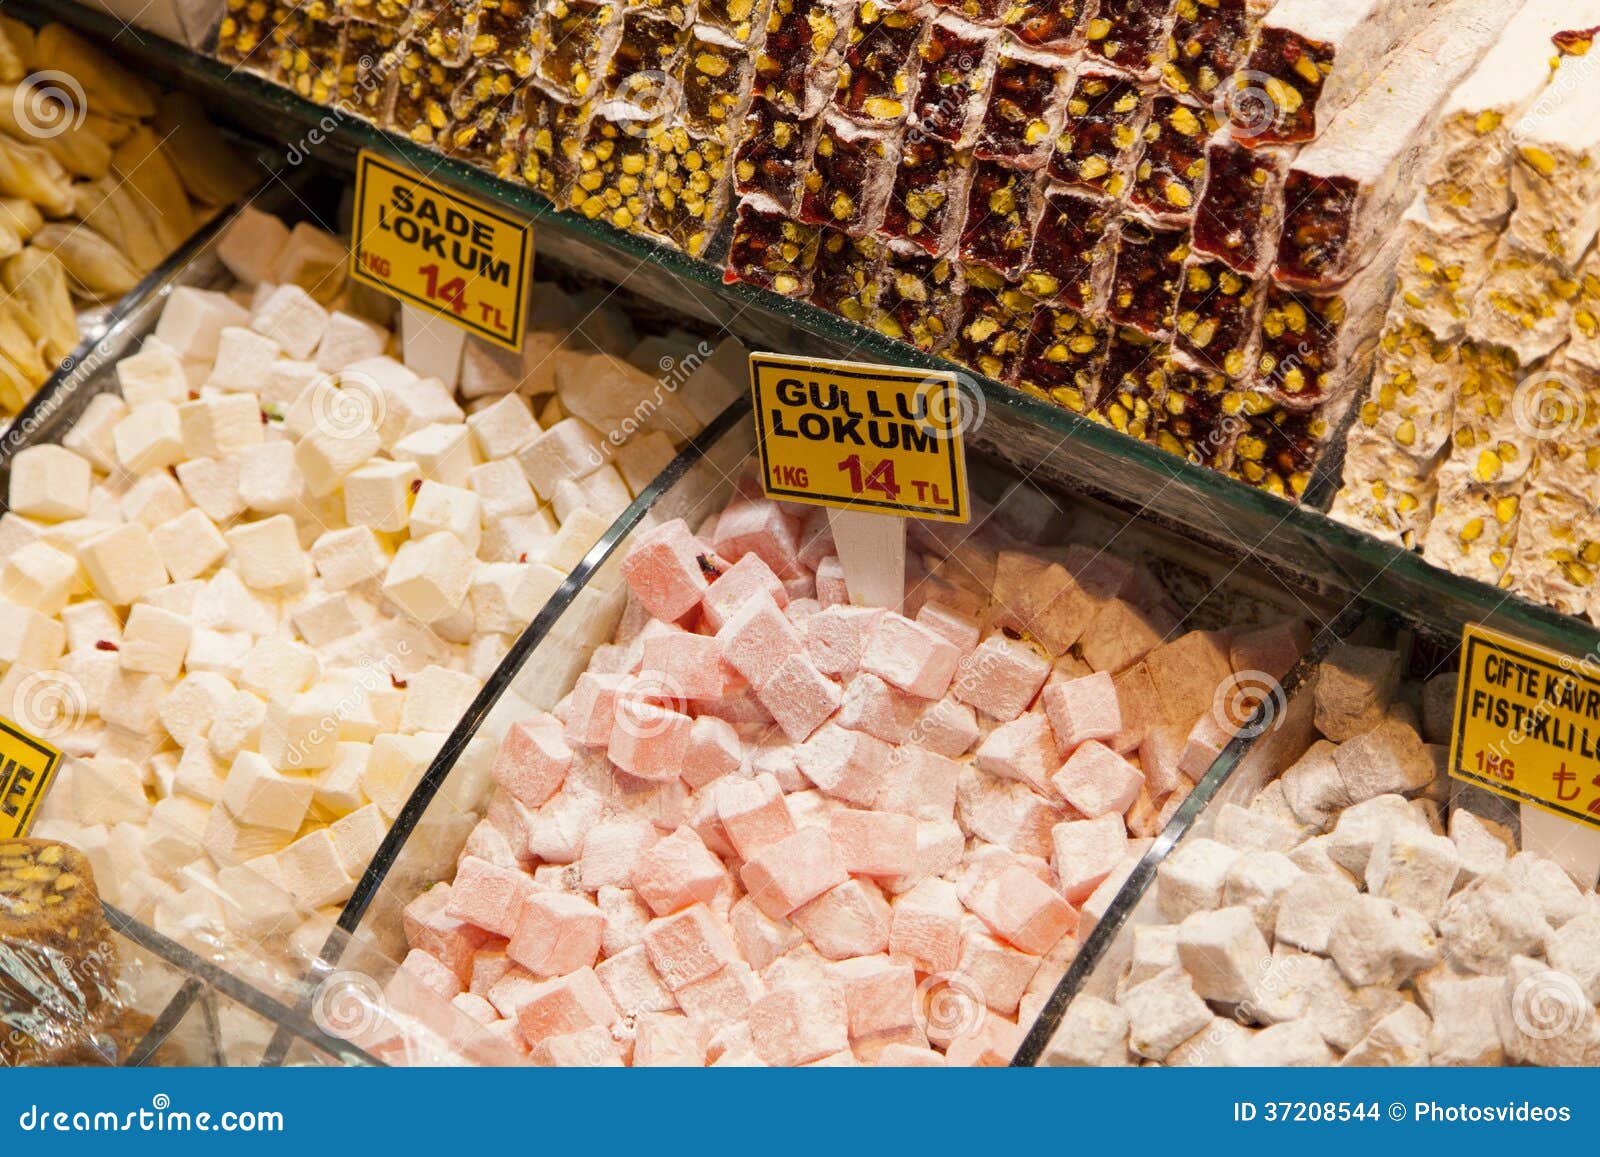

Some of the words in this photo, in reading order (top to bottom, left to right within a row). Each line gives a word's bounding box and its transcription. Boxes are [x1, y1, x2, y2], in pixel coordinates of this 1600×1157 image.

[391, 185, 494, 251] SADE
[379, 204, 511, 288] LOKUM
[361, 251, 392, 278] 1KG
[418, 263, 469, 314] 14
[479, 302, 508, 331] TL
[772, 409, 939, 454] LOKUM
[773, 464, 809, 488] 1KG
[838, 454, 900, 500] 14
[911, 480, 949, 504] TL
[1475, 750, 1515, 782] 1KG
[1581, 728, 1600, 762] L
